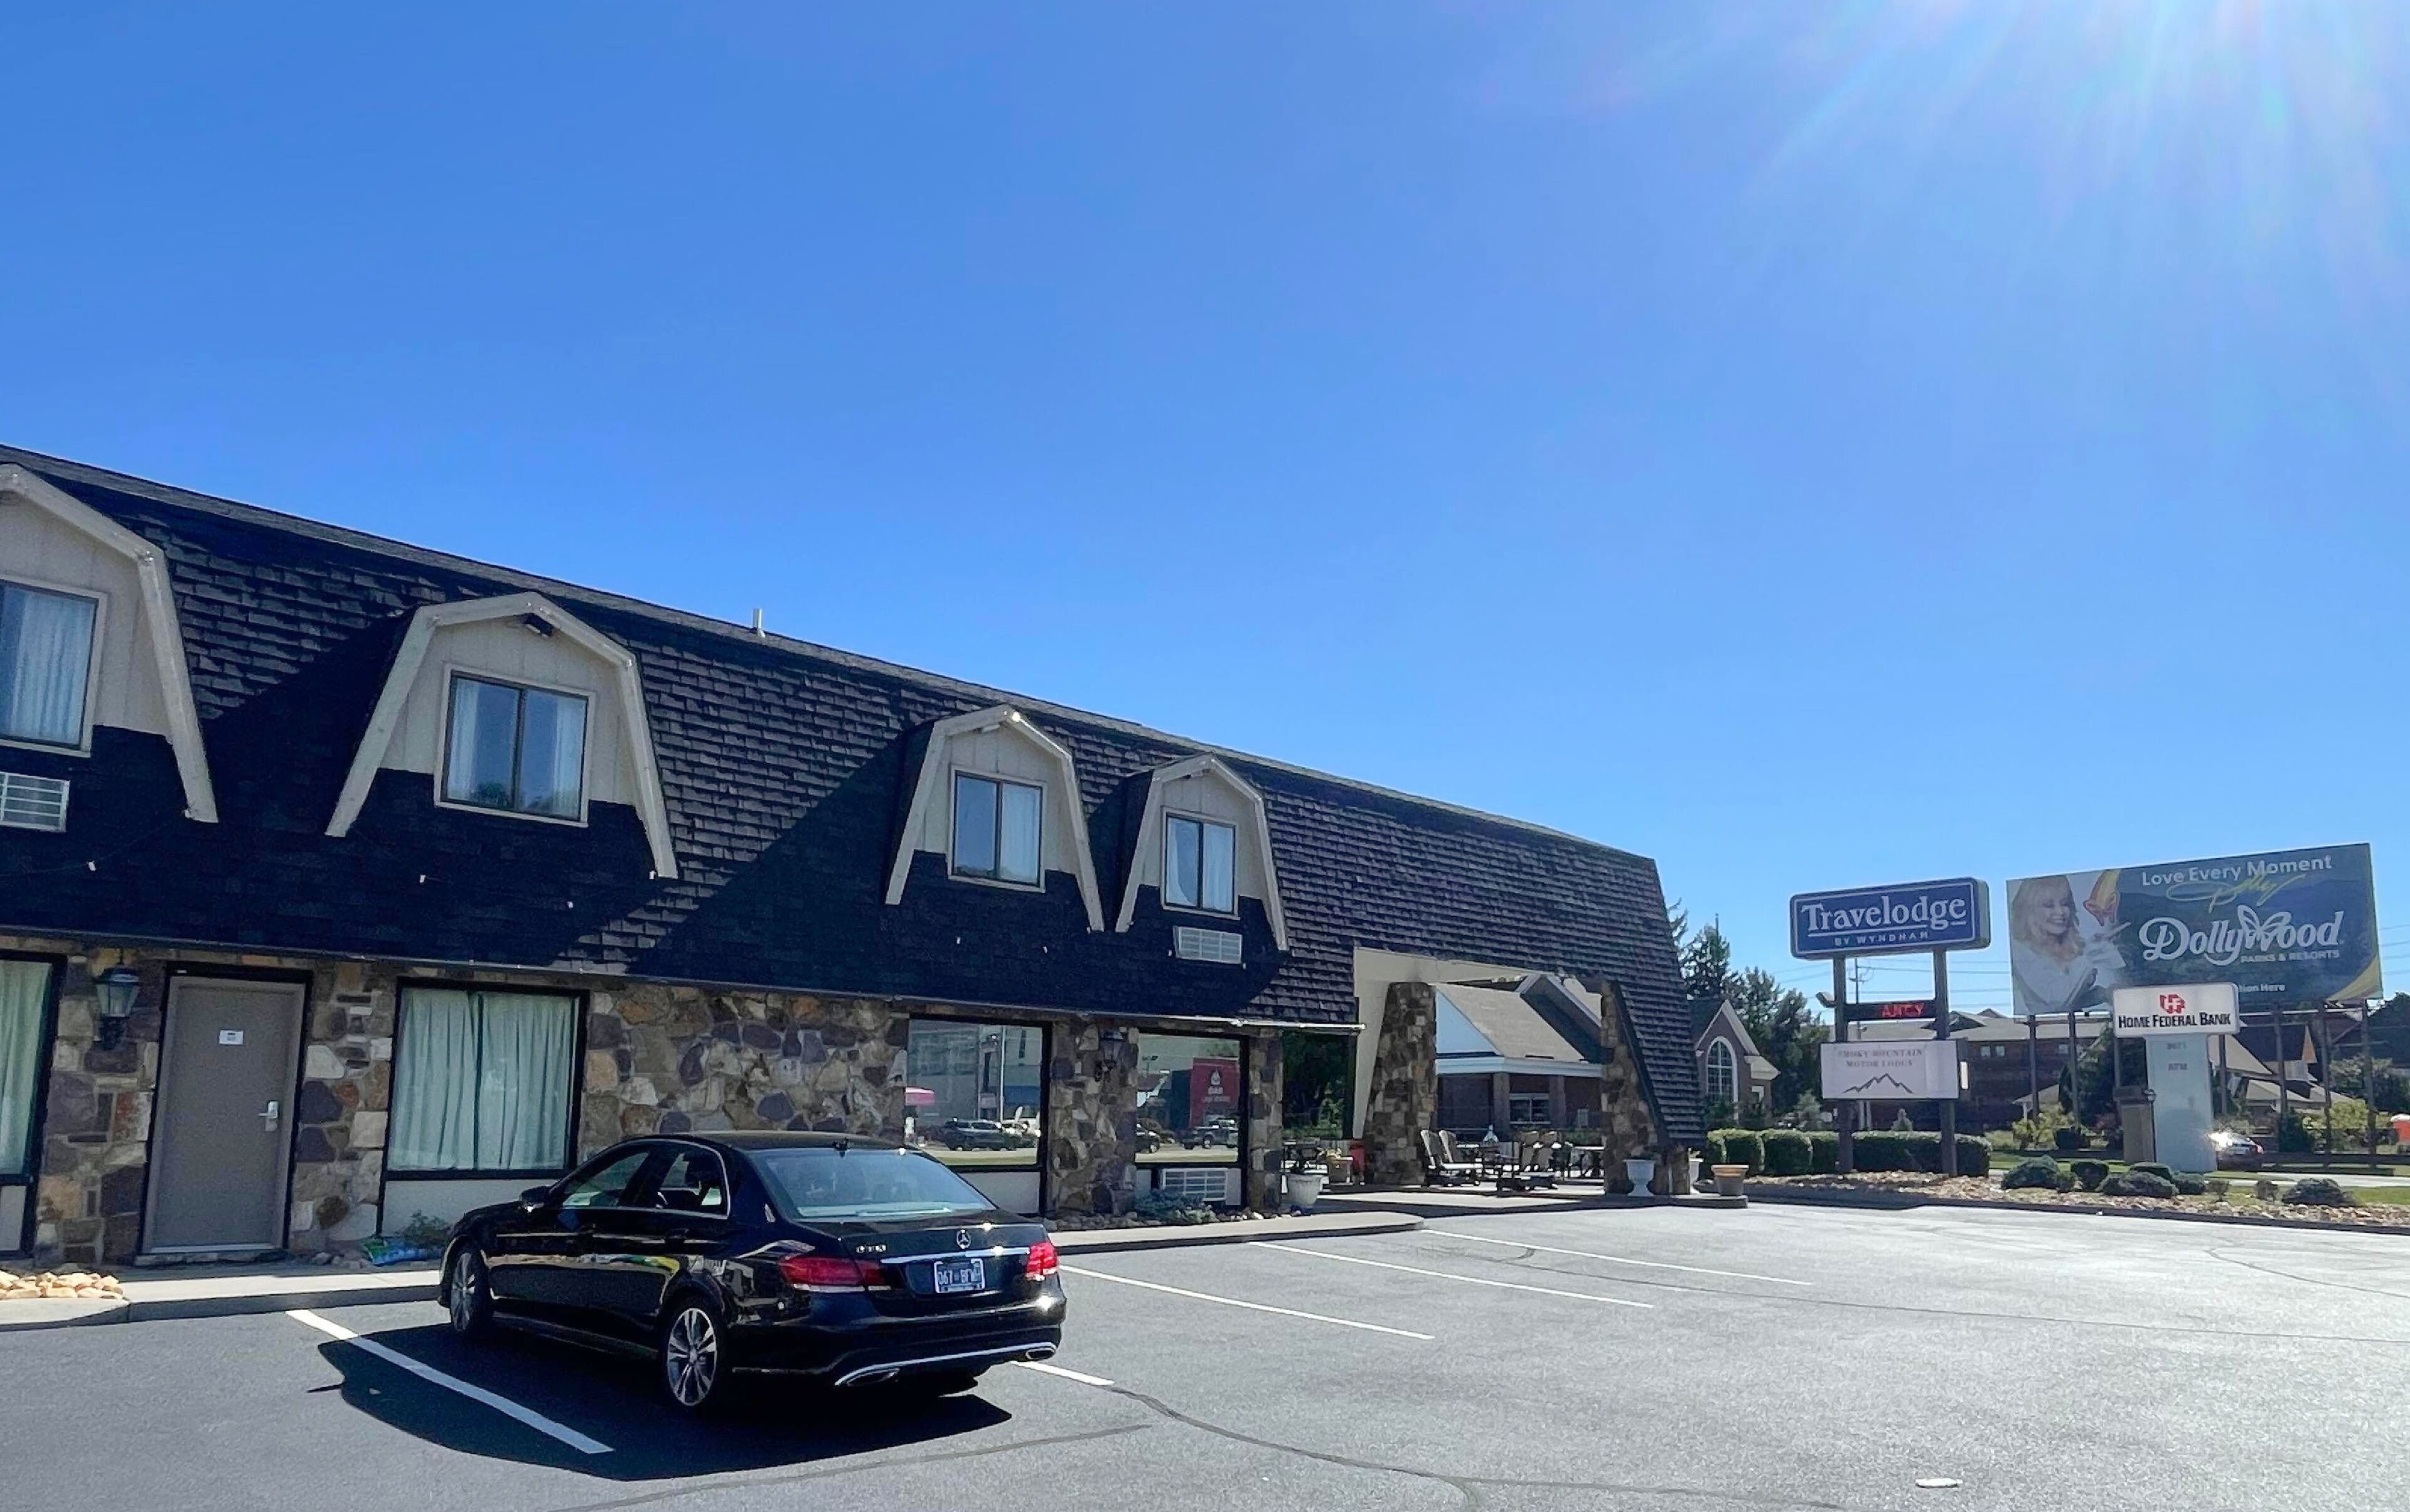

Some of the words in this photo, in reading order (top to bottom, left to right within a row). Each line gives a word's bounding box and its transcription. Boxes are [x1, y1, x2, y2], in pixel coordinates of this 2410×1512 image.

[2141, 871, 2184, 886] Love
[2188, 866, 2241, 881] Every
[2247, 855, 2332, 877] Moment
[1801, 895, 1967, 931] Travelodge
[1834, 937, 1850, 946] BY
[1857, 931, 1929, 944] WYNDHAM
[2118, 1014, 2150, 1029] HOME
[2152, 1014, 2198, 1027] FEDERAL
[2199, 1012, 2231, 1026] BANK
